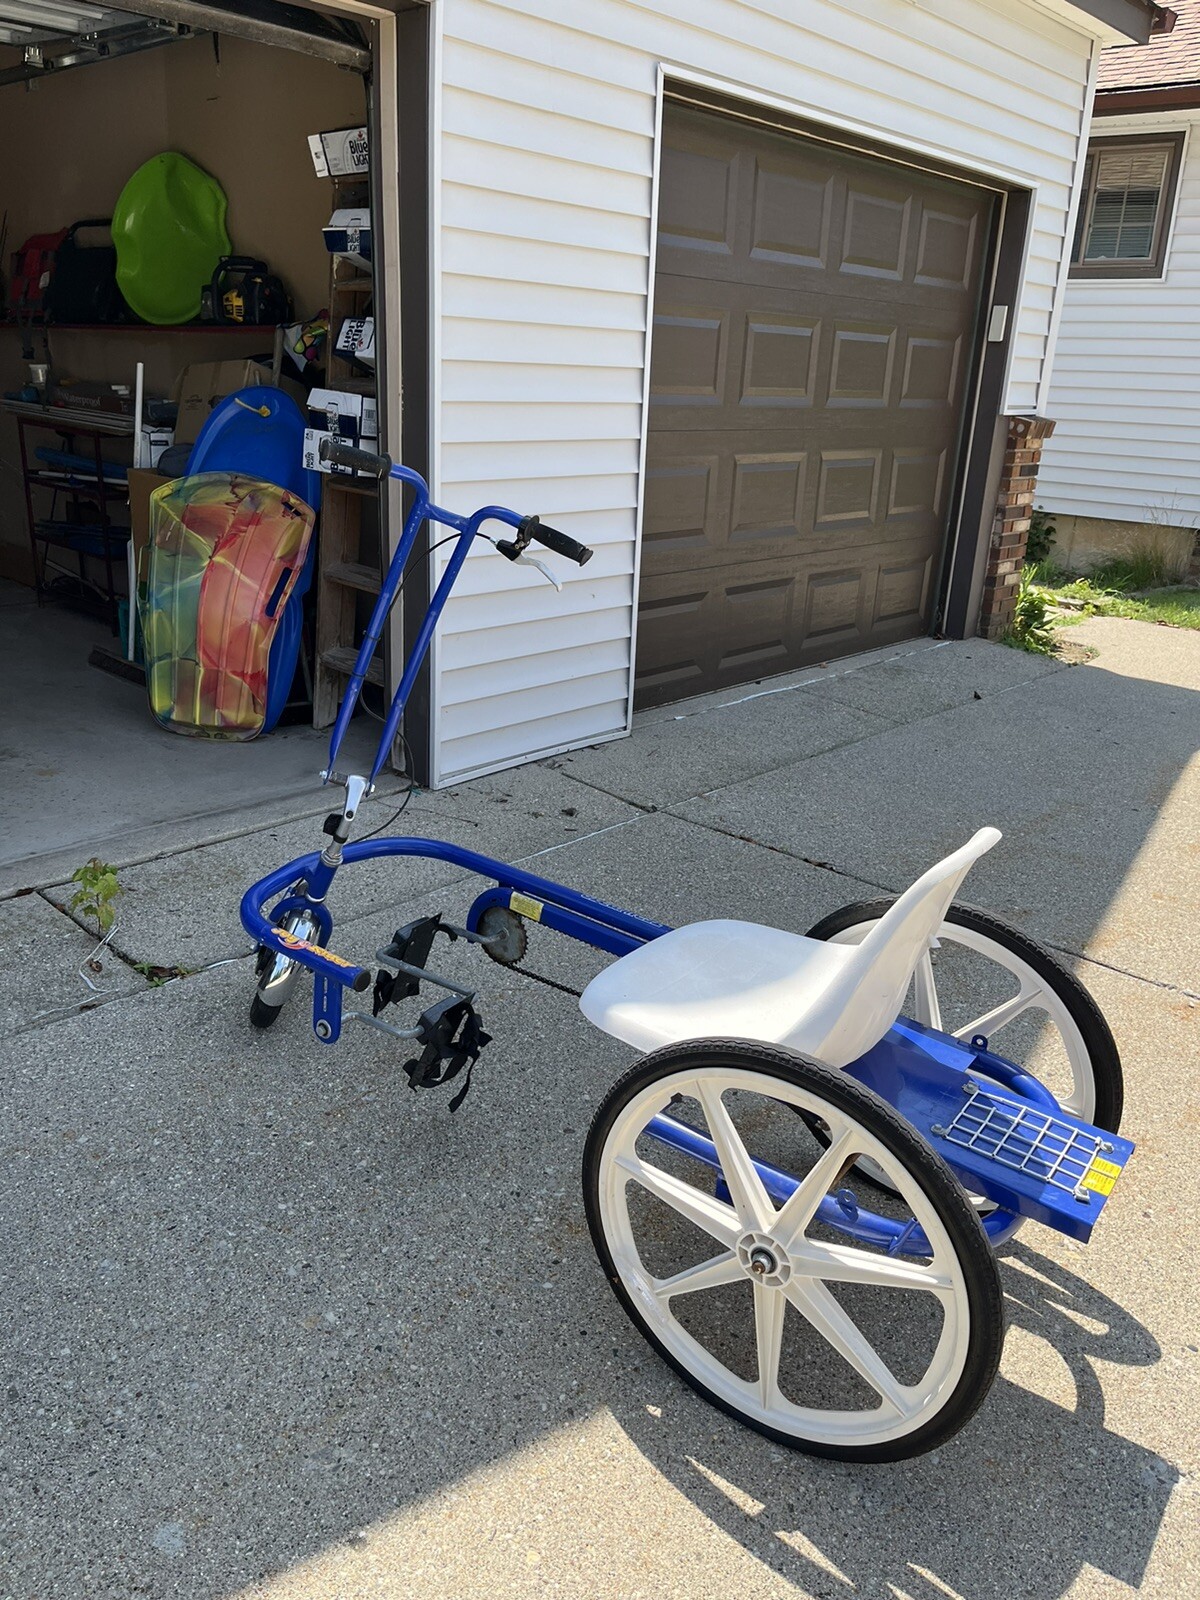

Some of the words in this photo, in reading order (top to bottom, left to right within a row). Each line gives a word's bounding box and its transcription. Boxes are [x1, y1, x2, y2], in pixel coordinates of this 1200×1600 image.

[348, 139, 368, 154] Blue
[352, 153, 369, 166] LIGH
[342, 320, 358, 349] LIGHT
[350, 320, 365, 350] Blue
